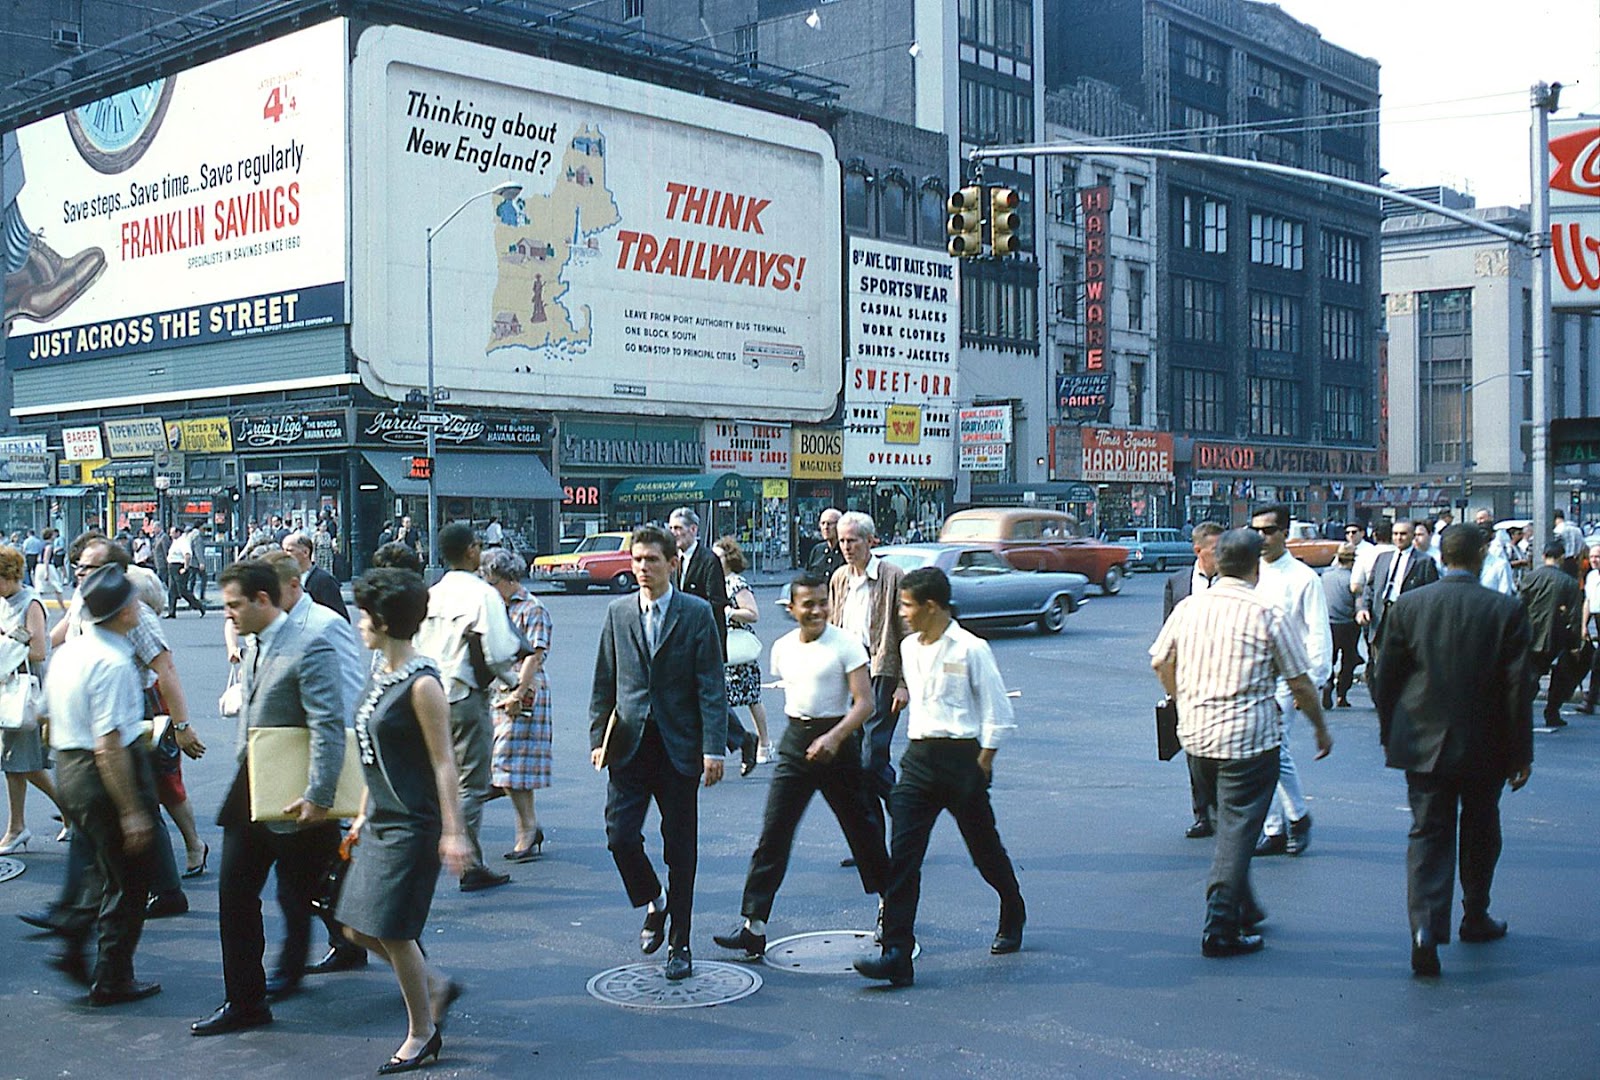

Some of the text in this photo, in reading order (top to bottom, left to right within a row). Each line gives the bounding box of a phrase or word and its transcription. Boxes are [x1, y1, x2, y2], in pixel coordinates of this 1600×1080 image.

[406, 90, 557, 144] Thinking about
[406, 126, 552, 175] New England?
[63, 200, 88, 224] Save
[237, 139, 304, 185] regularly
[665, 181, 772, 235] THINK
[121, 182, 300, 261] FRANKLIN SAVINGS
[188, 252, 223, 269] SPECIALISTS
[225, 250, 231, 261] IN
[234, 243, 262, 260] SAVINGS
[265, 239, 283, 253] SINCE
[616, 230, 807, 292] TRAILWAYS!
[885, 255, 902, 272] CUT
[904, 258, 925, 275] RATE
[926, 261, 953, 280] STORE
[860, 276, 948, 303] SPORTSWEAR
[1087, 193, 1104, 370] HARDWARE
[861, 302, 947, 323] CASUAL SLACKS
[30, 293, 299, 360] JUST ACROSS THE STREET
[625, 309, 786, 334] LEAVE FROM PORT AUTHORITY BUS TERMINAL
[625, 326, 697, 341] ONE BLOCK SOUTH
[863, 323, 946, 343] WORK CLOTHES
[625, 343, 636, 352] GO
[672, 347, 681, 356] TO
[683, 348, 714, 360] PRINCIPAL
[716, 351, 736, 361] CITIES
[858, 344, 950, 363] SHIRTS JACKETS
[854, 368, 951, 396] SWEET-ORR
[1061, 395, 1106, 406] PAINTS
[853, 408, 878, 419] WORK
[926, 413, 949, 423] WORK
[66, 430, 97, 443] BARBER
[108, 422, 161, 439] TYPEWRITERS
[187, 424, 208, 433] PETER
[325, 428, 342, 438] CIGAR
[716, 424, 781, 438] TOYS TRICKS
[850, 424, 880, 434] PANTS
[923, 427, 950, 437] SHIRTS
[136, 440, 165, 451] MACHINES
[187, 435, 207, 448] FOOD
[487, 433, 541, 442] HAVANA CIGAR
[801, 434, 841, 455] BOOKS
[1095, 430, 1158, 449] Times Square
[73, 445, 94, 457] SHOP
[710, 449, 787, 464] GREETING CARDS
[962, 445, 1003, 455] SWEET-ORR
[800, 461, 842, 472] MAGAZINES
[869, 453, 932, 465] OVERALLS
[1082, 448, 1168, 472] HARDWARE
[1262, 448, 1329, 474] CAFETERIA
[321, 478, 340, 487] CANDY
[634, 481, 696, 491] SHANNON INN
[619, 491, 704, 503] HOT PLATES SANDWICHES
[724, 490, 741, 499] BAR
